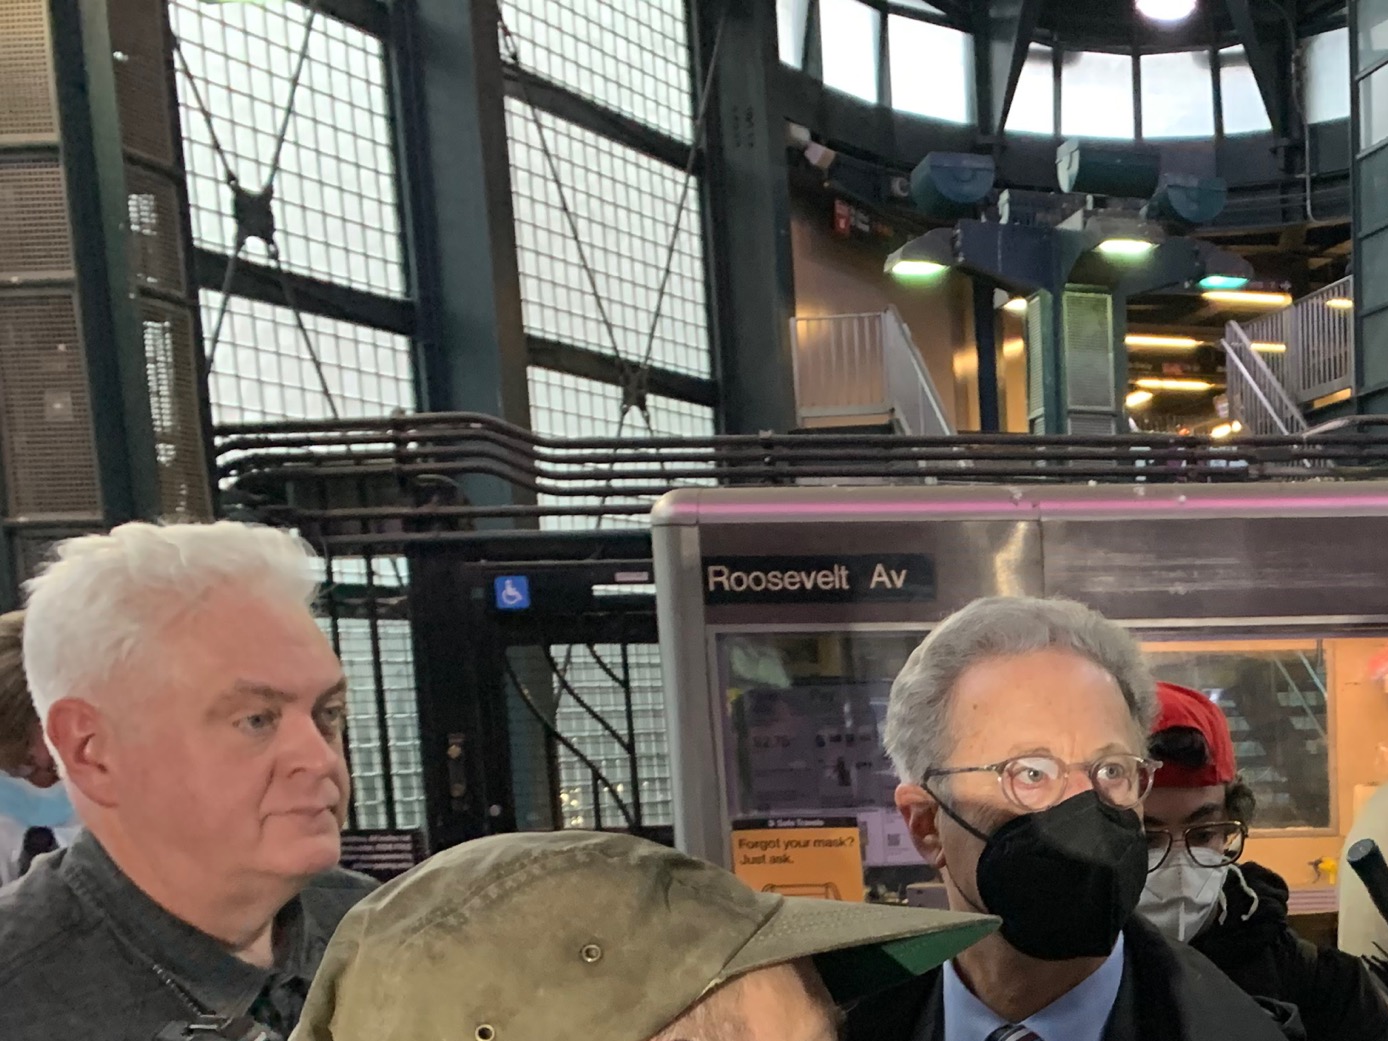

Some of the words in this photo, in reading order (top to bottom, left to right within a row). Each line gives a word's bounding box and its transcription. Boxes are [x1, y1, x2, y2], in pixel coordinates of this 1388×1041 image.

[708, 564, 849, 592] Roosevelt
[870, 563, 908, 589] Av
[738, 838, 780, 850] Forgot
[783, 839, 810, 850] your
[813, 836, 855, 848] mask?
[740, 854, 766, 865] Just
[769, 853, 794, 864] ask.
